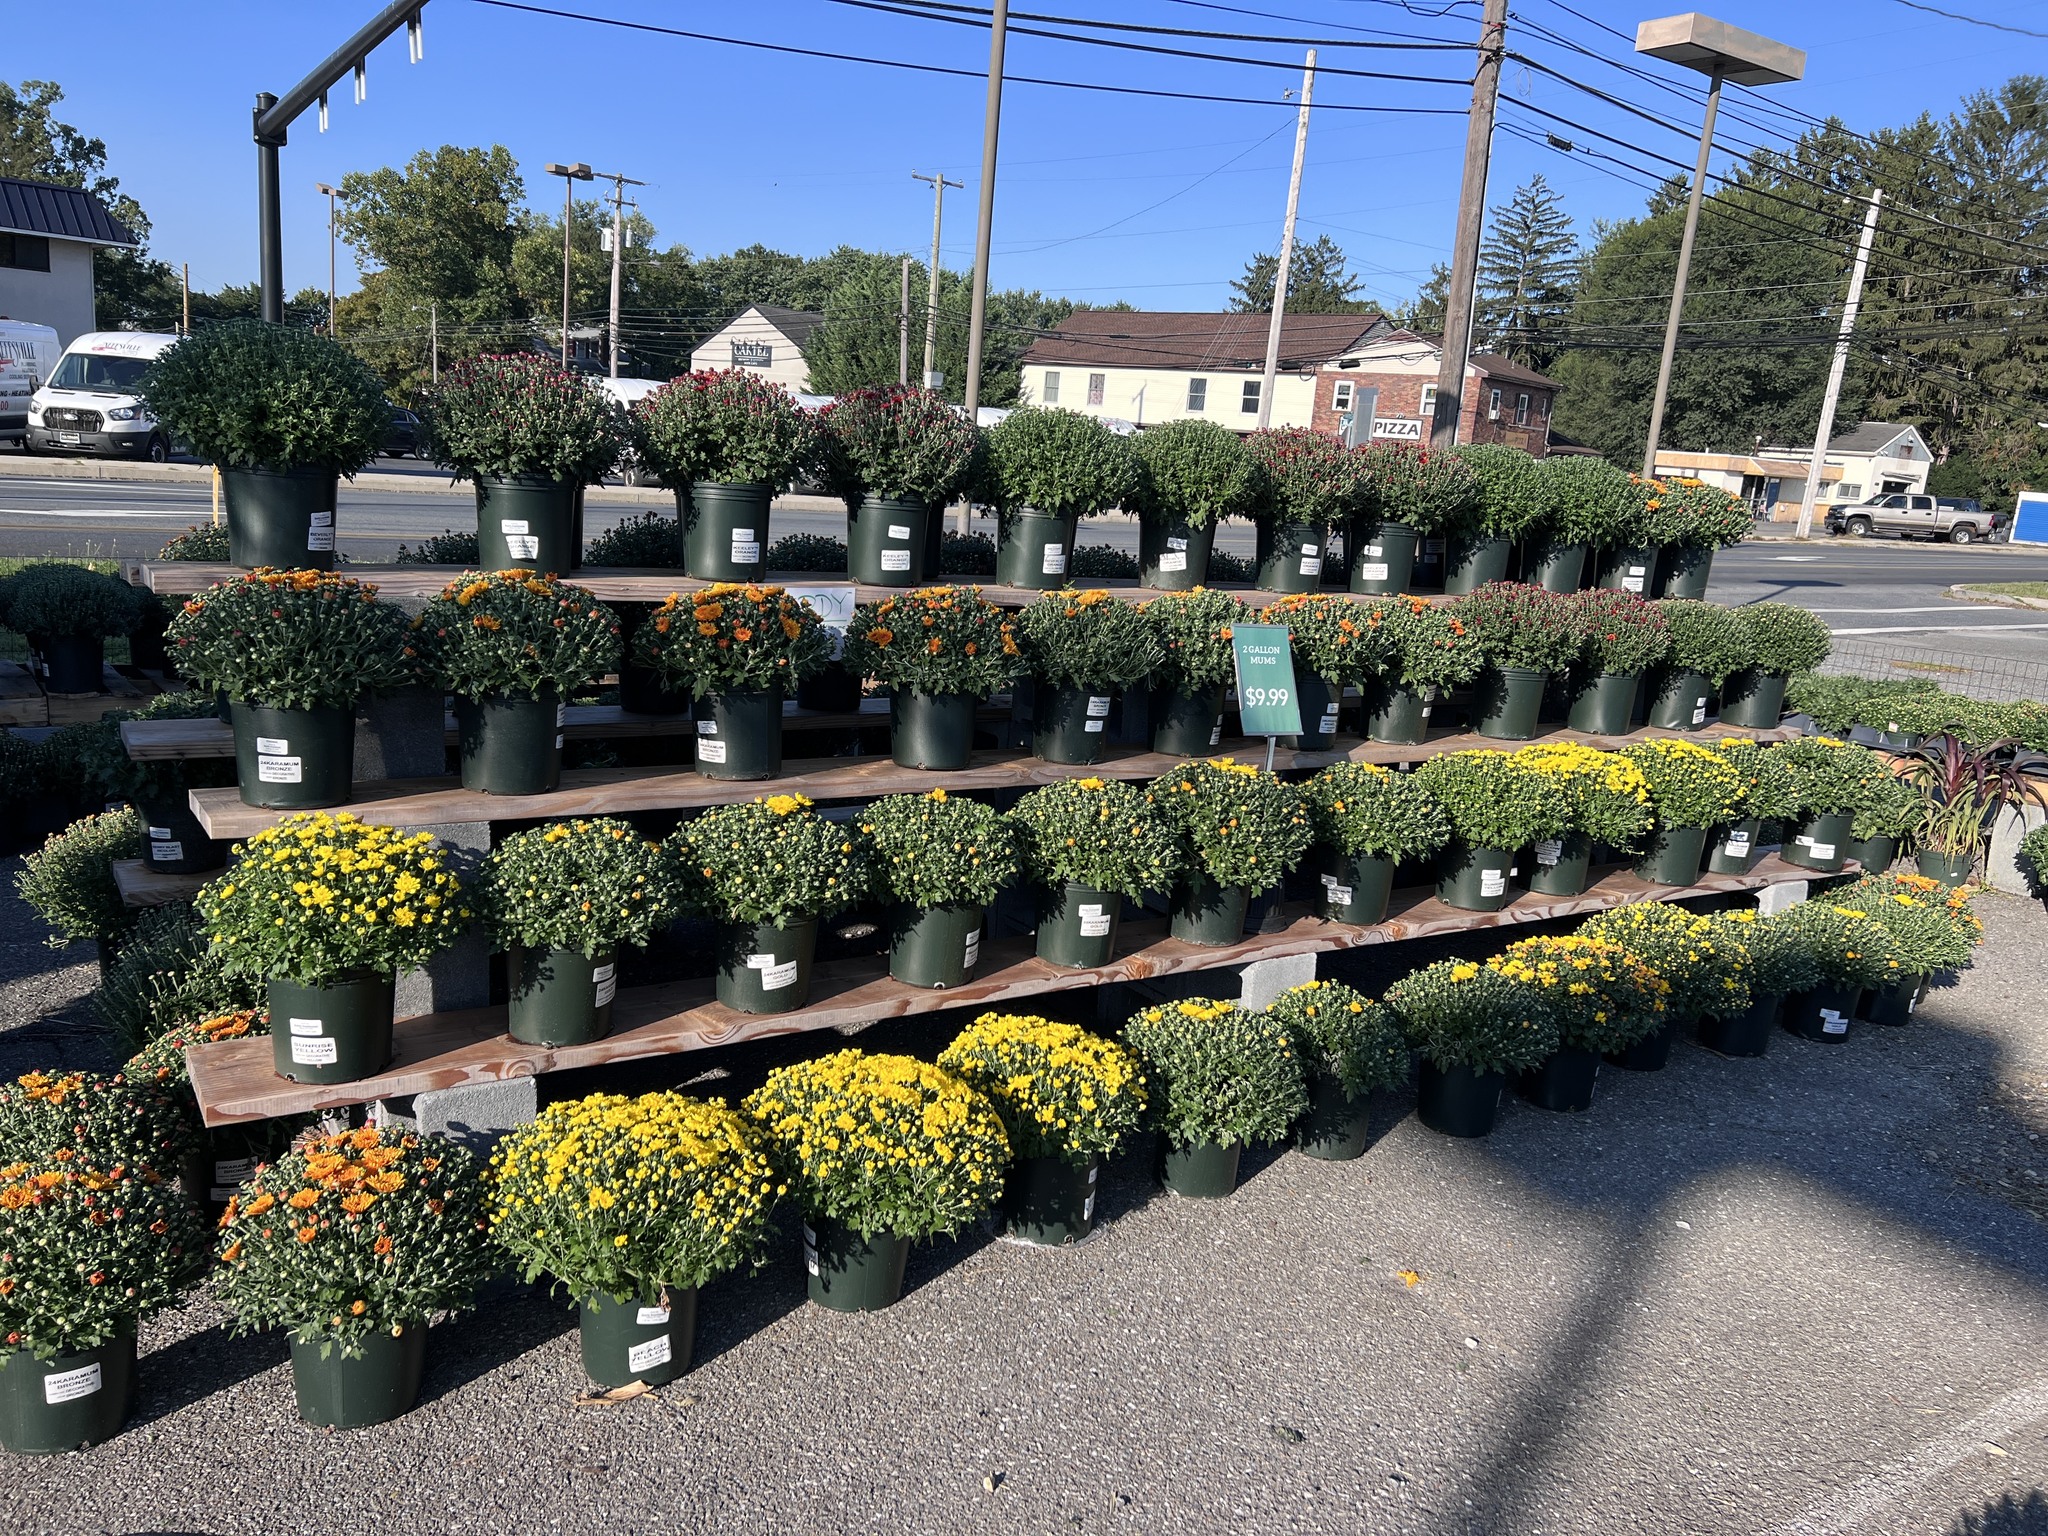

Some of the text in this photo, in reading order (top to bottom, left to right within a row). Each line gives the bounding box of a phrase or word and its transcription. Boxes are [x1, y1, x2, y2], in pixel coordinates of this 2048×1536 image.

[1373, 421, 1419, 436] PIZZA
[1242, 645, 1280, 655] 2 GALLON
[1250, 656, 1276, 665] MUMS
[1245, 686, 1289, 709] $9.99
[631, 1346, 670, 1362] YELLOW
[47, 1368, 99, 1386] 24KARAMUM
[57, 1376, 91, 1390] BRONZE
[65, 1381, 95, 1393] DECORATIVE
